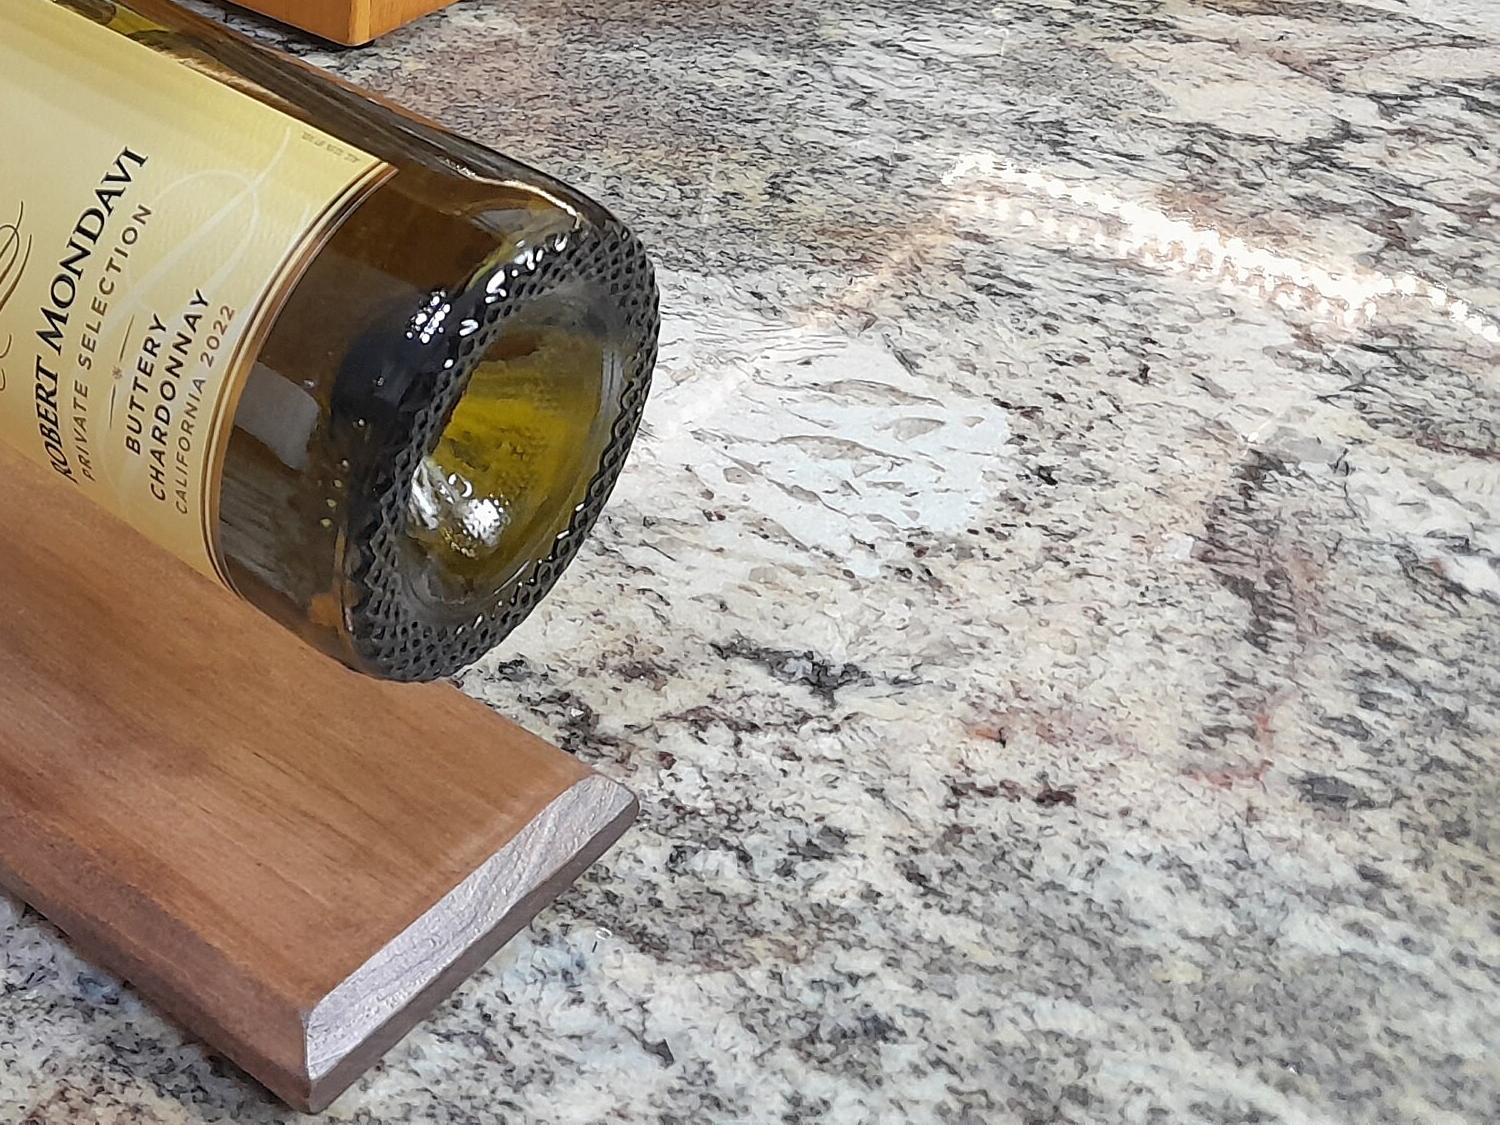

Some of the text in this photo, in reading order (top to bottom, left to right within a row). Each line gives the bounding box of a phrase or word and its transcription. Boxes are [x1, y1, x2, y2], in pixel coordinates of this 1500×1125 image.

[35, 146, 149, 486] ROBERT MONDAVI
[73, 204, 152, 484] PRIVATE SELECTION
[125, 313, 167, 455] BUTTERY
[150, 288, 210, 502] CHARDONNAY
[175, 305, 236, 514] CALIFORNIA 2022
